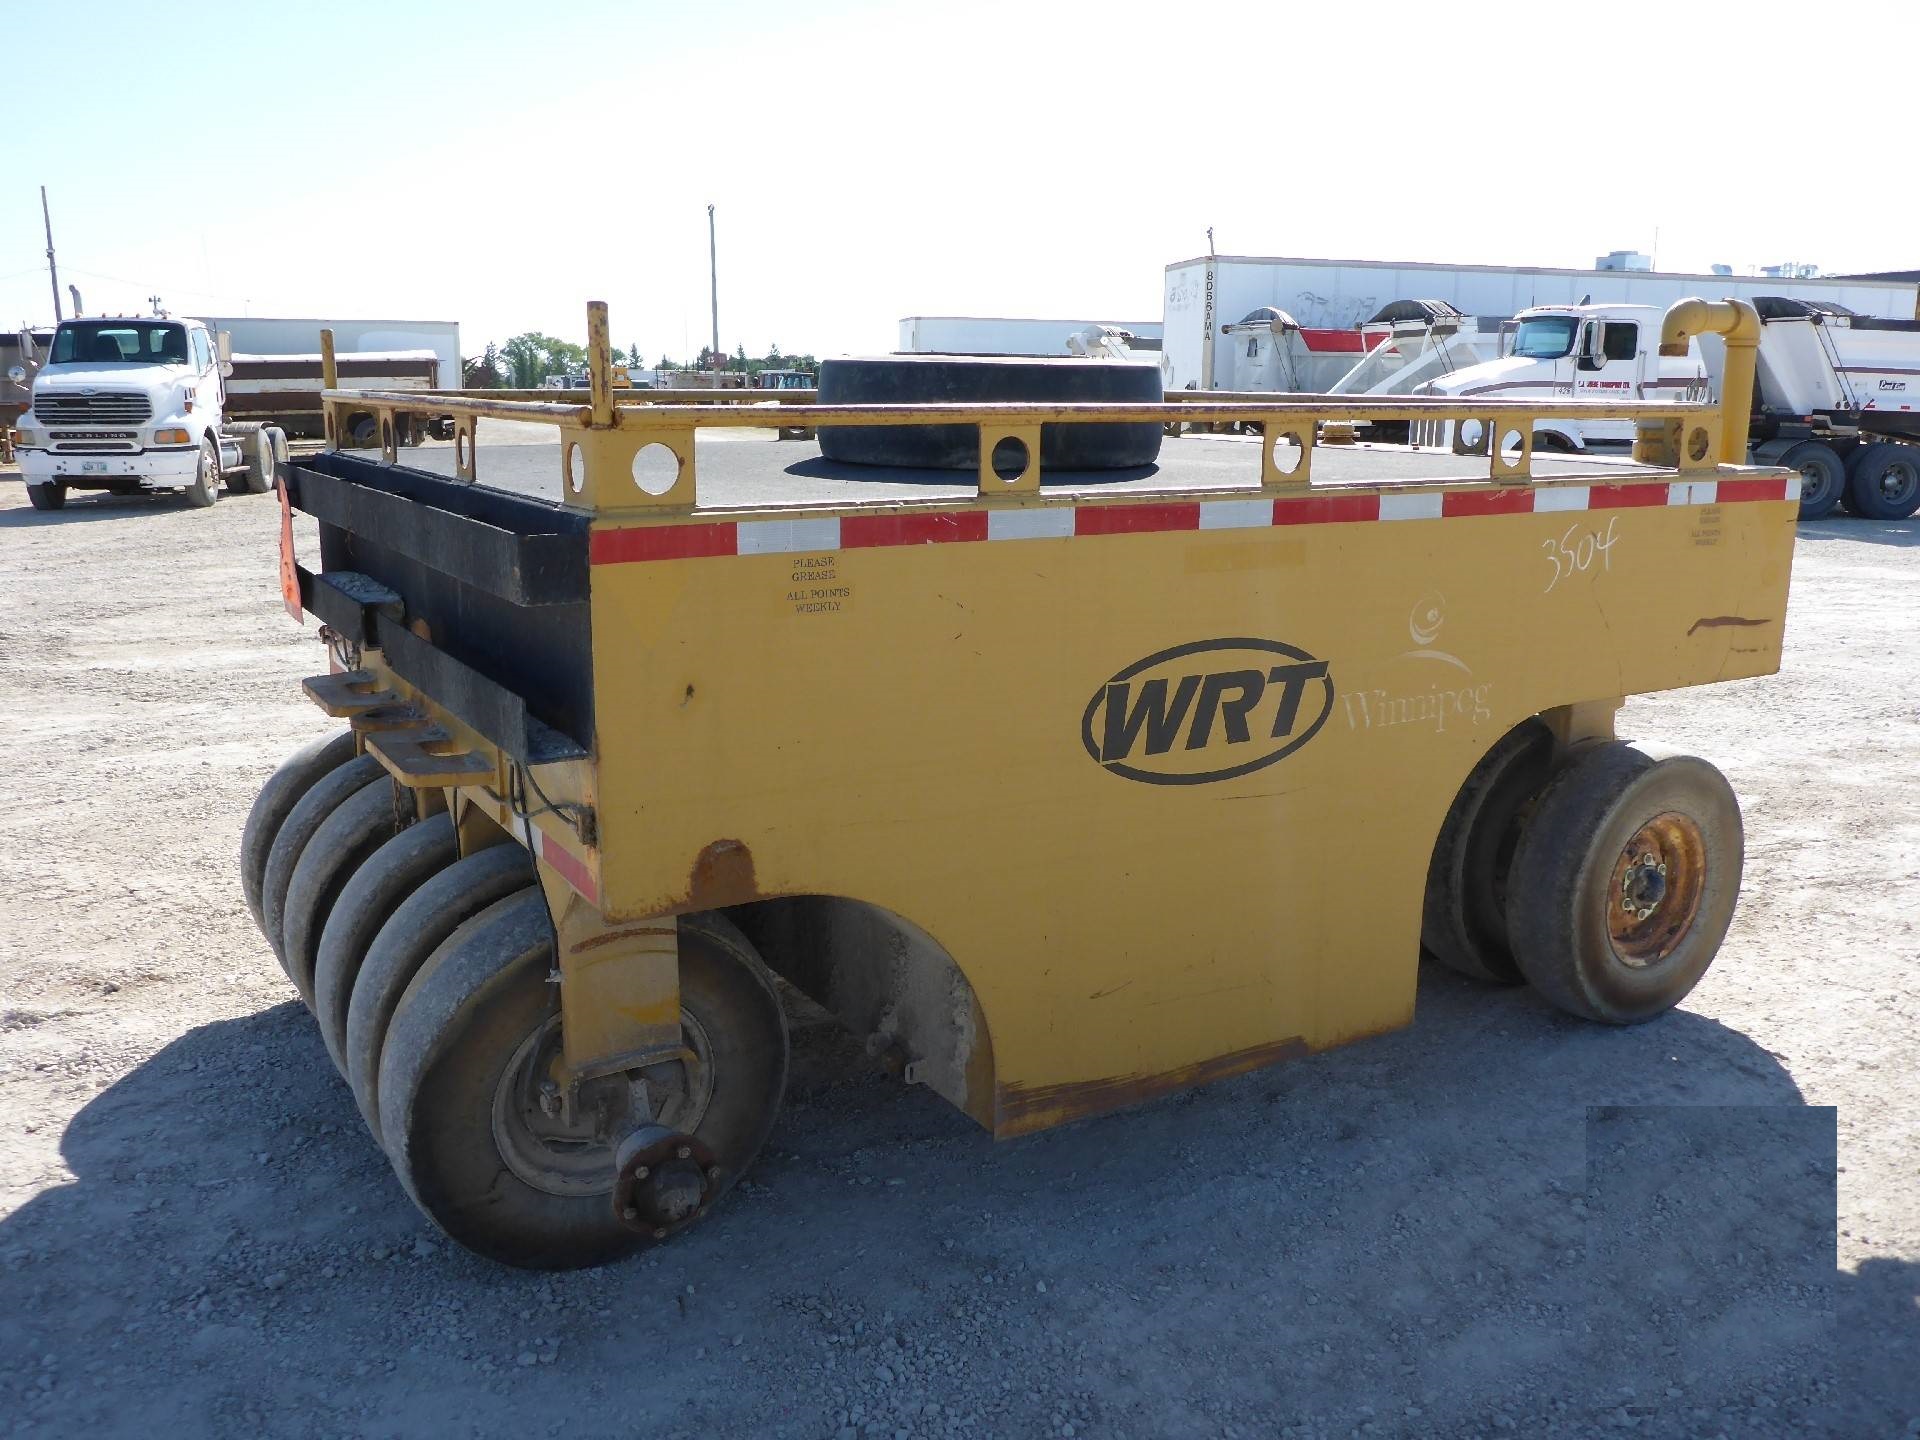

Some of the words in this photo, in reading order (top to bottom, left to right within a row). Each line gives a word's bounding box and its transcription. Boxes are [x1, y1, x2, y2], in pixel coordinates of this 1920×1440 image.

[1542, 516, 1620, 593] 3504
[793, 556, 835, 568] PLEASE
[791, 569, 837, 582] GREASE
[786, 590, 808, 601] ALL
[810, 587, 850, 599] POINTS
[795, 601, 841, 613] WEEKLY
[1102, 661, 1329, 761] WRT
